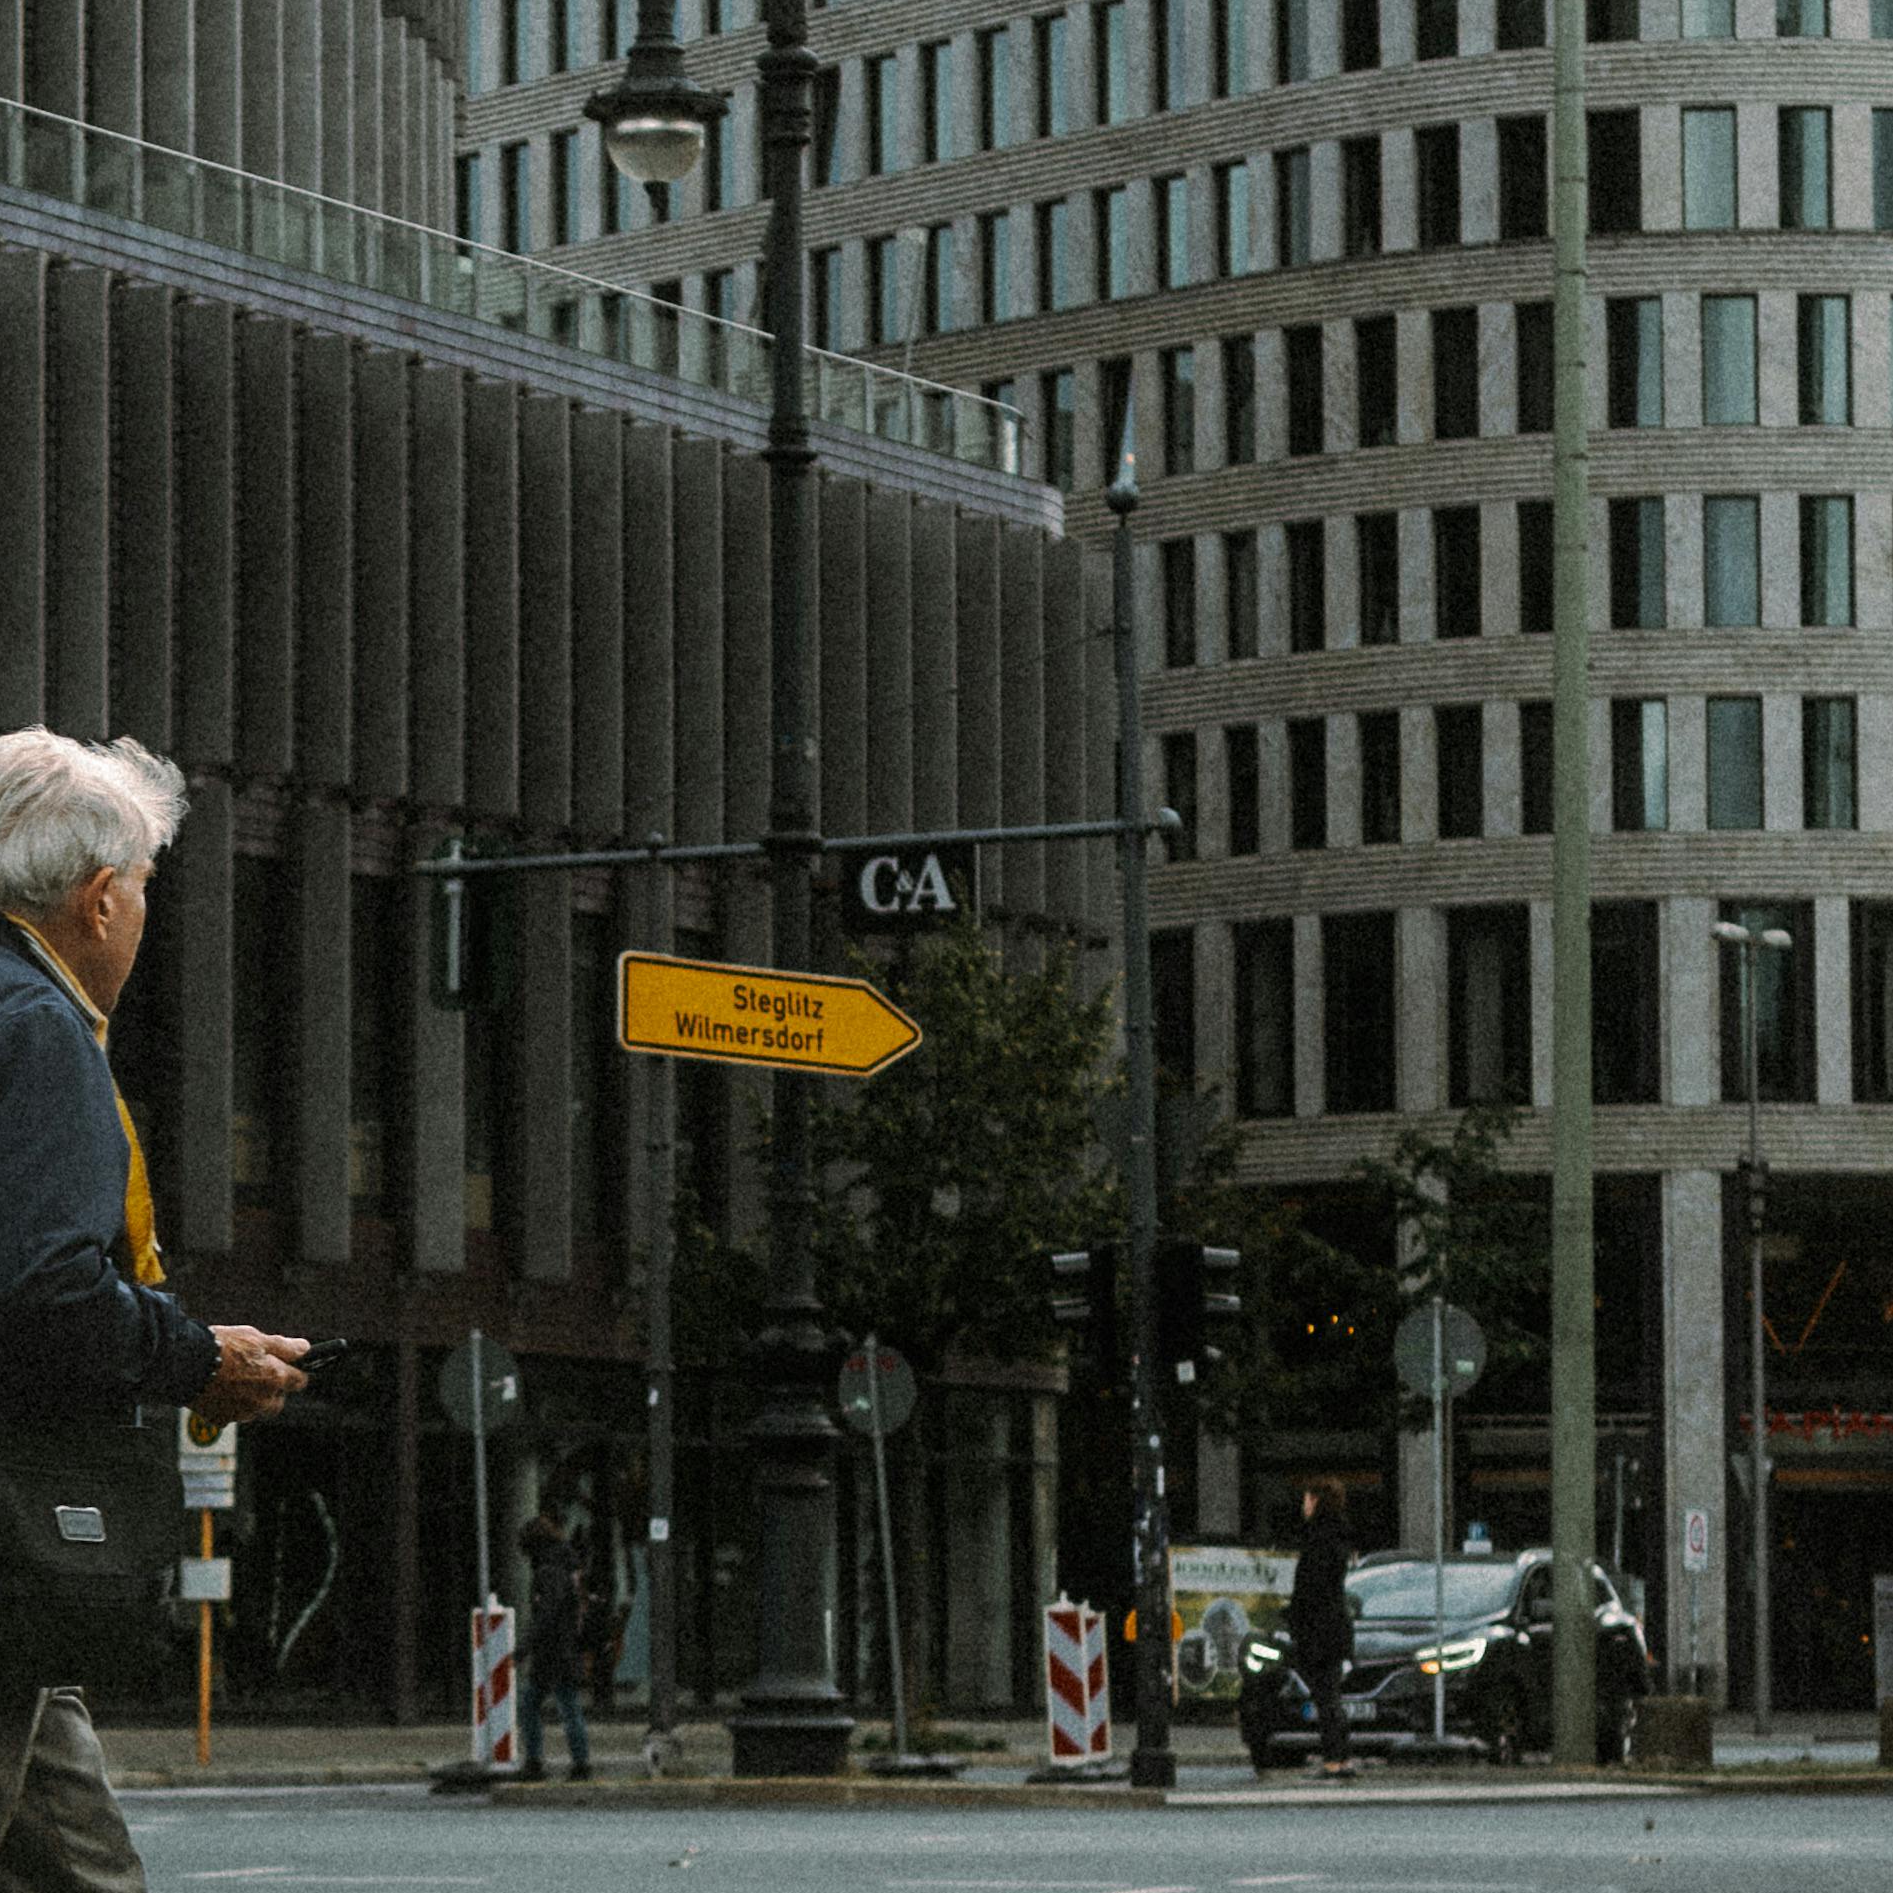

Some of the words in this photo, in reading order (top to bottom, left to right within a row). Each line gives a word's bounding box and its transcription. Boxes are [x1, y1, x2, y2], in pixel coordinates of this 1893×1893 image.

[859, 852, 956, 914] C&A
[732, 983, 825, 1022] Steglitz
[674, 1010, 826, 1054] Wilmersdorf
